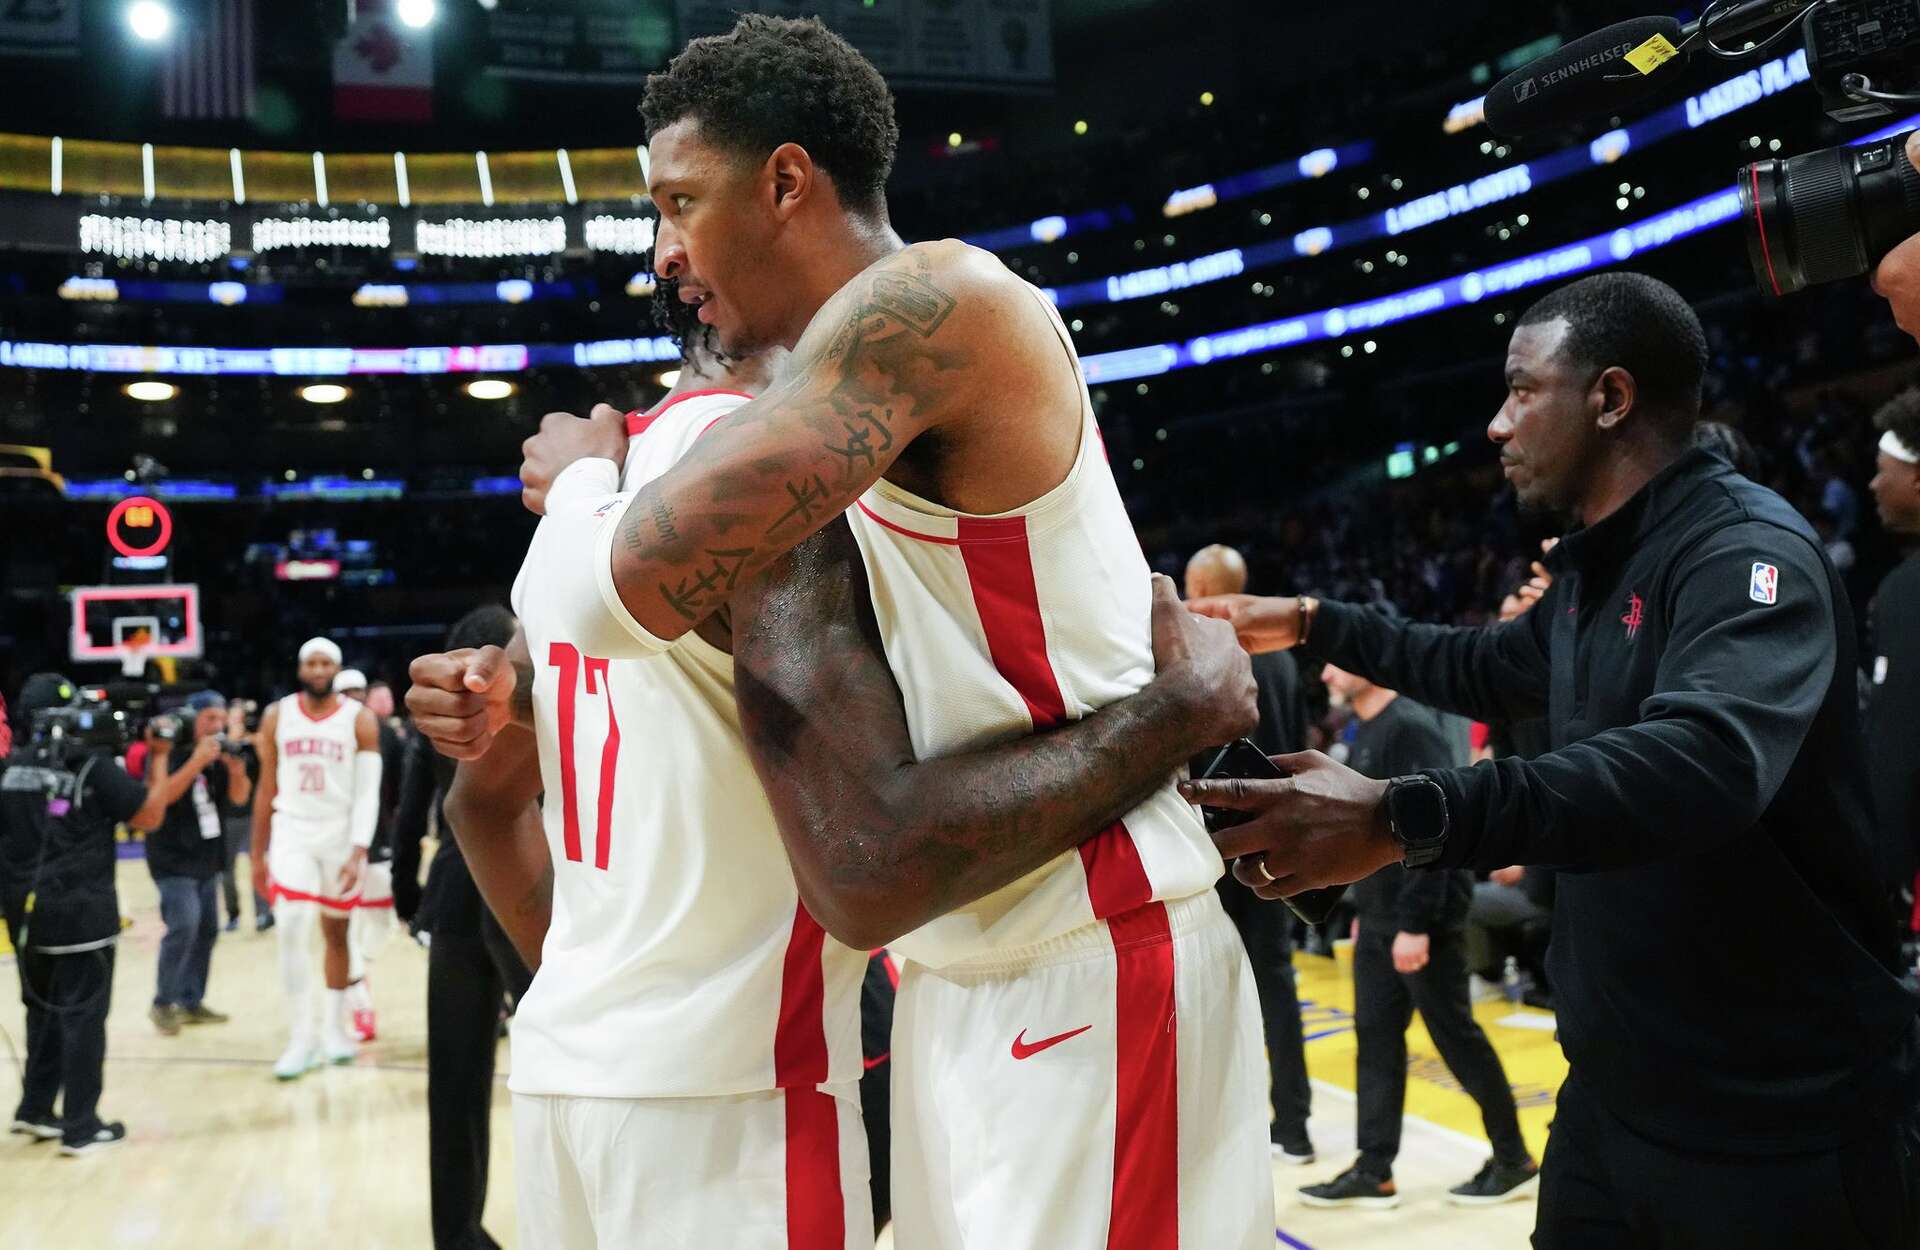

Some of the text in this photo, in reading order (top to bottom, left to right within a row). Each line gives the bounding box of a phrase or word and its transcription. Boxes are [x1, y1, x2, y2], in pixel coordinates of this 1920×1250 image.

[1540, 42, 1633, 88] SENNHEISER
[299, 764, 325, 793] 20
[549, 642, 620, 870] 17
